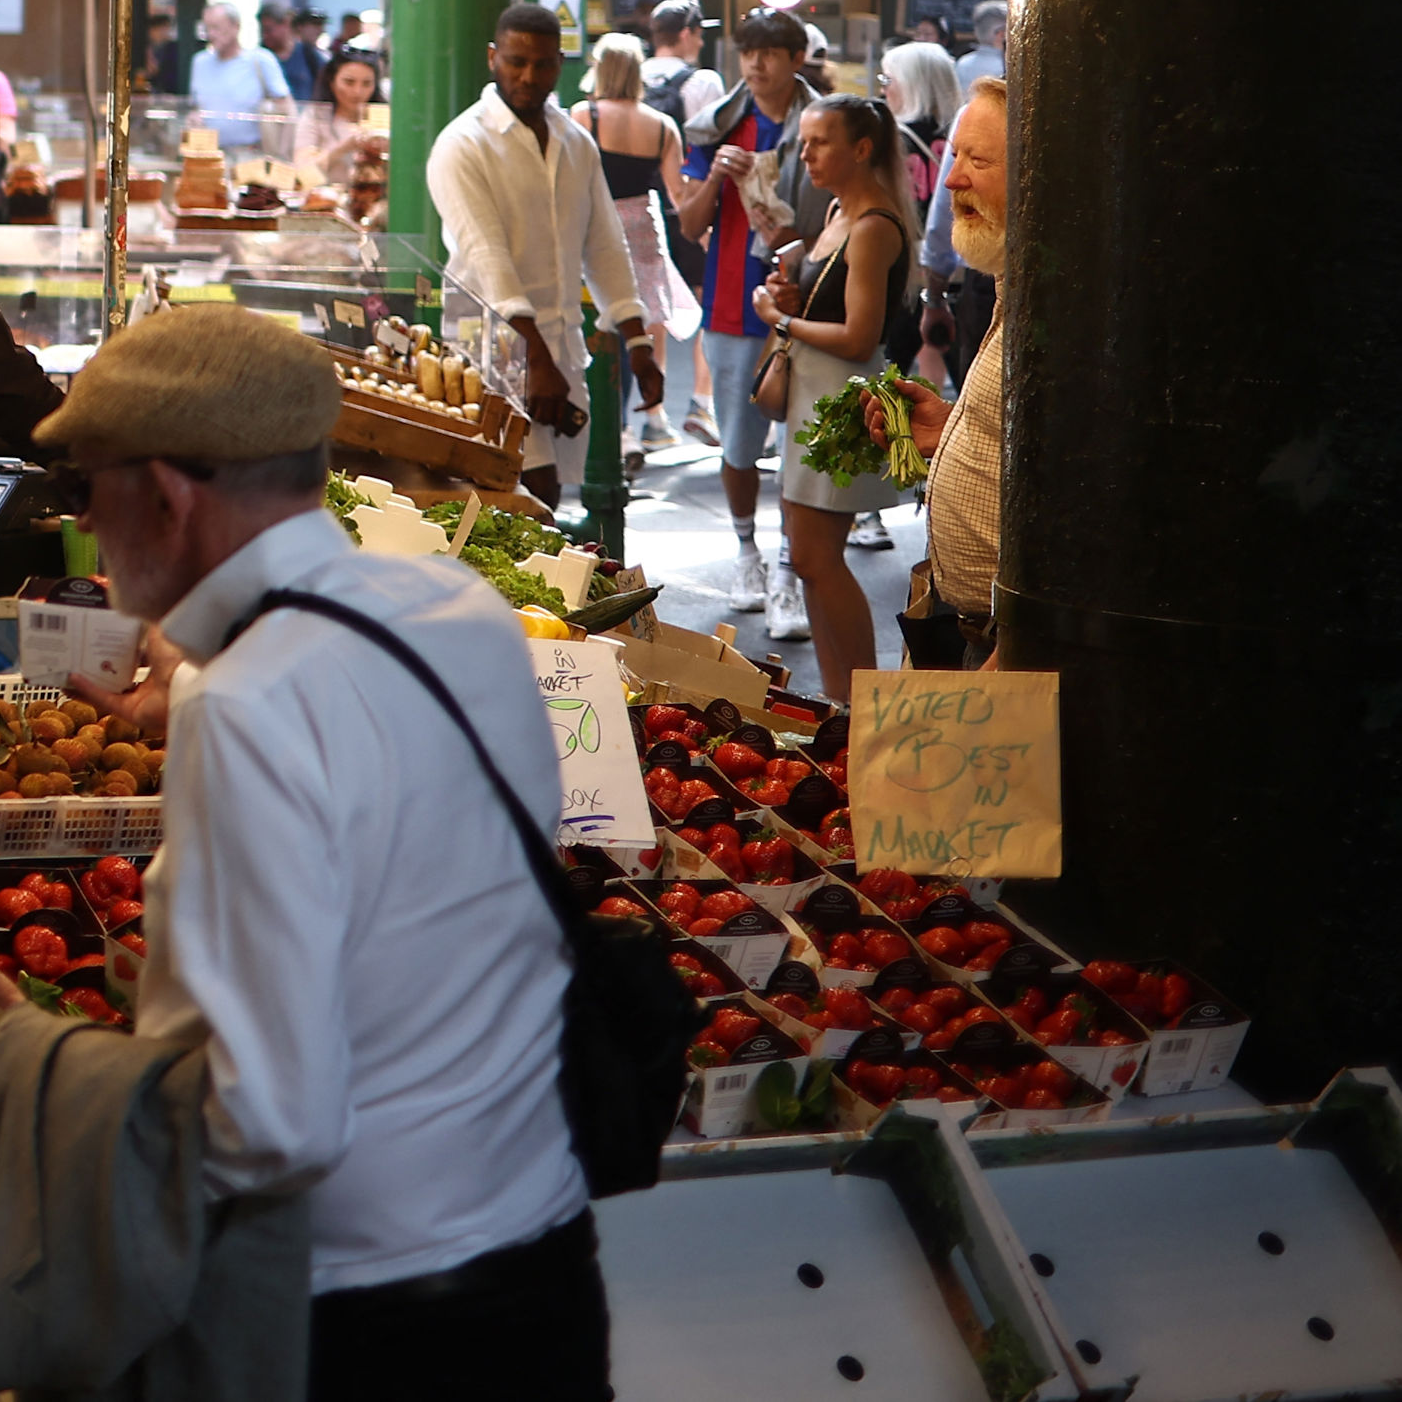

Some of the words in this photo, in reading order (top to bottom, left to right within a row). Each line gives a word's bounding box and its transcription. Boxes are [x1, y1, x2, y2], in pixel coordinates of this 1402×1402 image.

[537, 673, 593, 692] ARKET
[872, 679, 994, 731] VOTED
[867, 815, 1023, 863] MARKET
